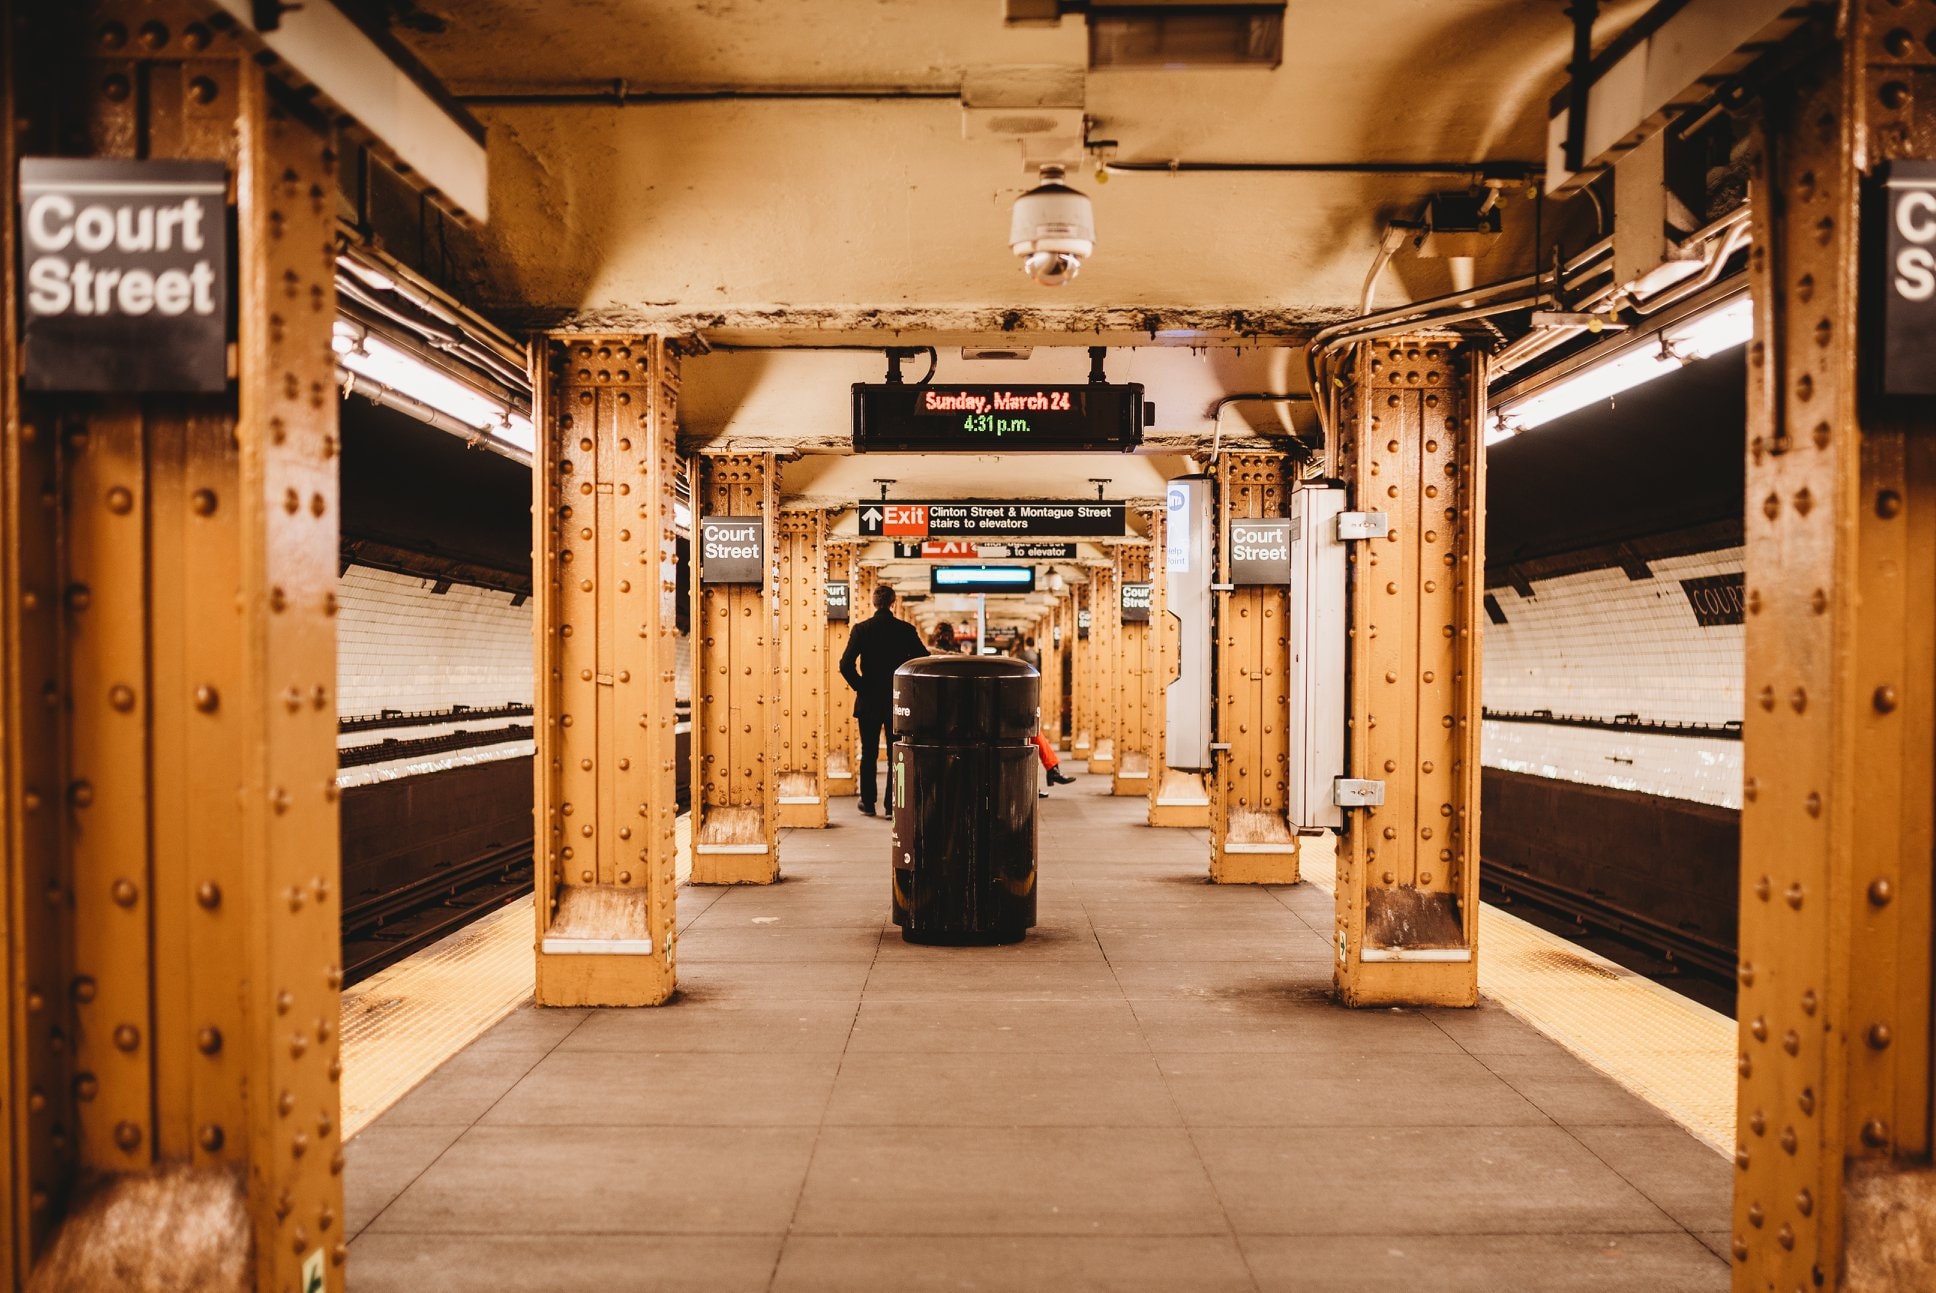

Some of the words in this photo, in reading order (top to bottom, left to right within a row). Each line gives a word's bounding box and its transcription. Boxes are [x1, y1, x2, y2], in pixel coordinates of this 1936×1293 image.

[27, 194, 204, 252] Court
[27, 256, 215, 317] Street
[925, 391, 992, 414] Sunday,
[994, 391, 1048, 411] March
[1050, 391, 1071, 411] 24
[964, 415, 993, 432] 4:31
[997, 417, 1031, 436] p.m.
[884, 506, 924, 525] Exit
[929, 506, 967, 517] Clinton
[970, 506, 1004, 517] Street
[1008, 506, 1017, 517] &
[1020, 506, 1074, 519] Montague
[1077, 506, 1112, 517] Street
[929, 518, 960, 528] stairs
[964, 518, 976, 528] to
[979, 518, 1029, 528] elevators
[704, 525, 756, 541] Court
[1232, 527, 1283, 543] Court
[705, 543, 760, 559] Street
[922, 542, 978, 554] Exi
[1014, 547, 1025, 557] to
[1028, 547, 1066, 557] elevator
[1233, 545, 1287, 561] Street
[827, 585, 845, 596] urt
[1122, 587, 1149, 597] Cour
[827, 596, 847, 606] eet
[1122, 597, 1150, 608] Stree
